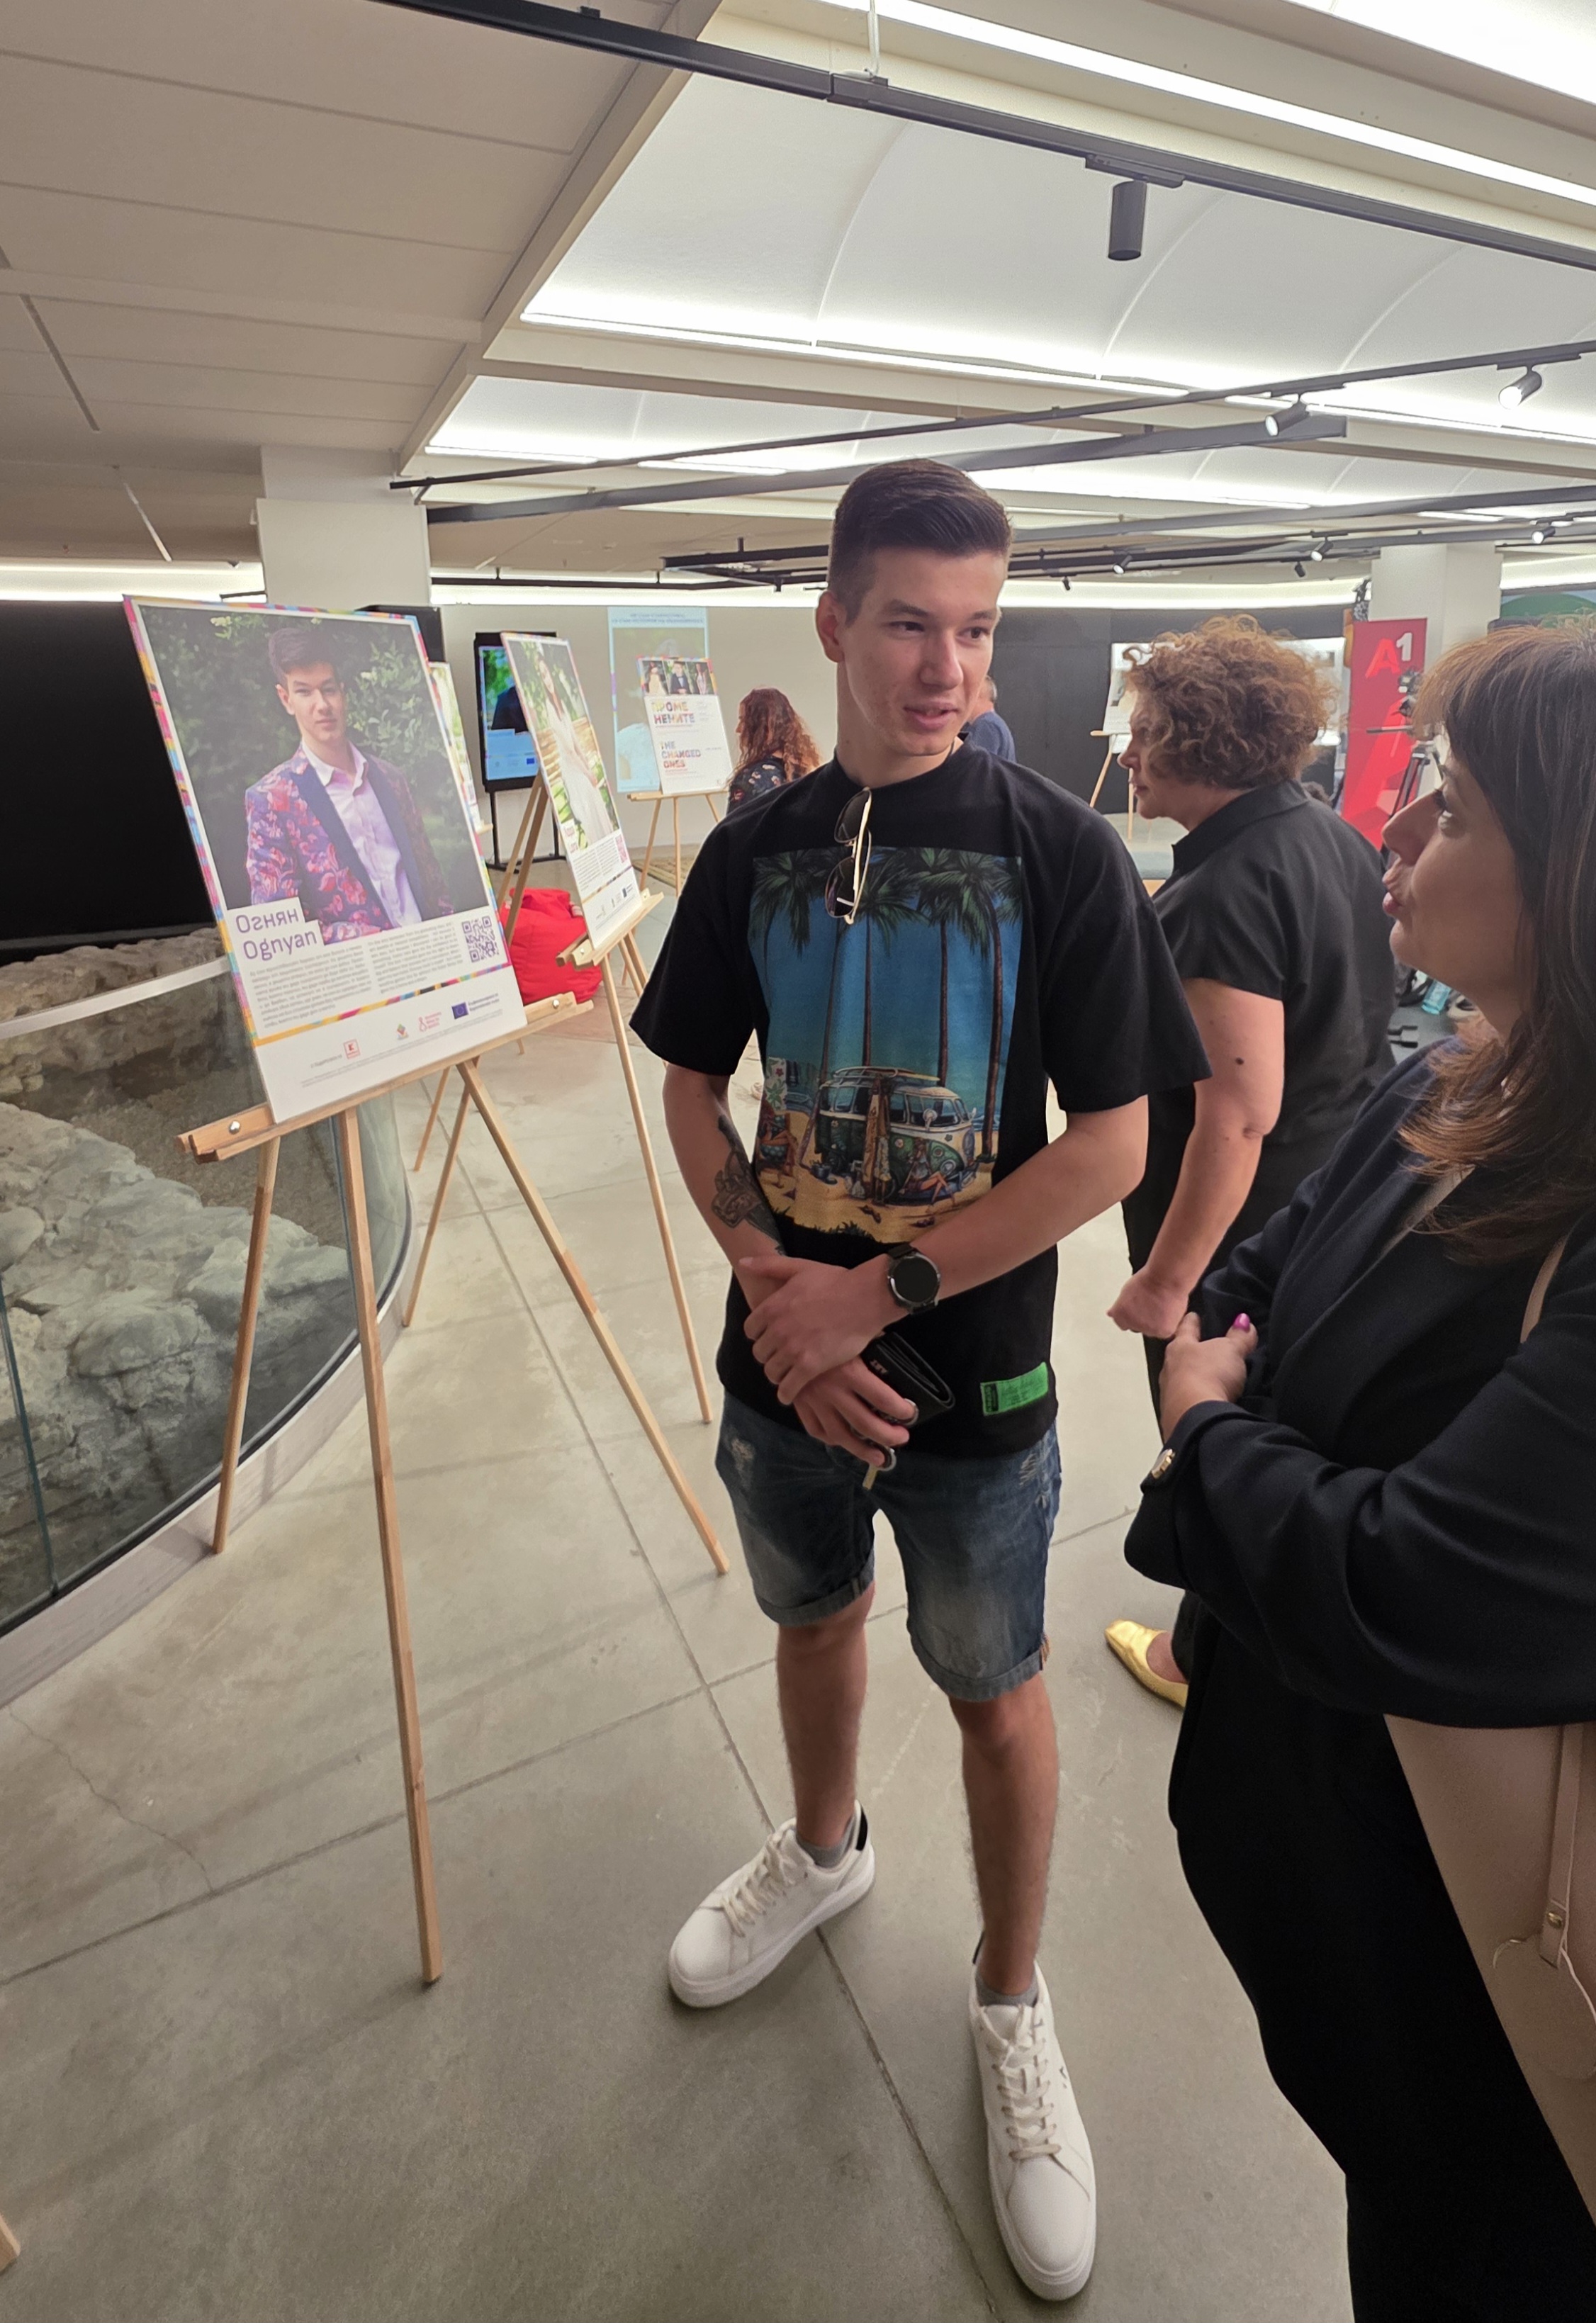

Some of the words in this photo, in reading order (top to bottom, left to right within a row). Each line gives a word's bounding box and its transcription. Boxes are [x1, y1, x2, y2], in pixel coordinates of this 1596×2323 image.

[1365, 632, 1412, 678] A1
[661, 749, 701, 759] CHANGED
[663, 760, 685, 768] ONES
[243, 931, 317, 961] Ognyan
